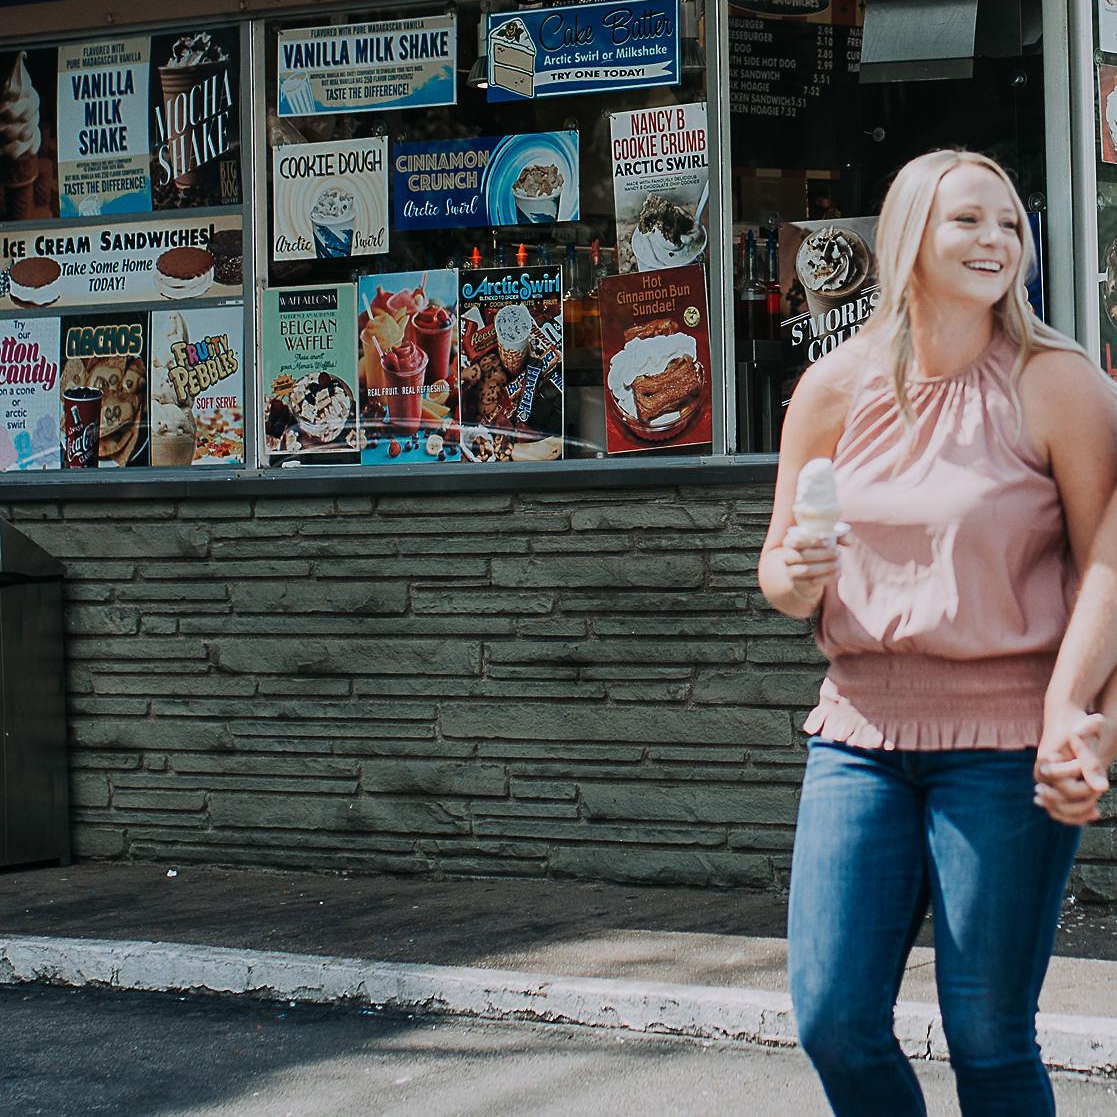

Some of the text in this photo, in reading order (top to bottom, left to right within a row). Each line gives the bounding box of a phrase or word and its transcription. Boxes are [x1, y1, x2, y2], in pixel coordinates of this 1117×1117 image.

[311, 21, 424, 38] FLAVORED WITH PURE MADAGASCAR VANILLA
[539, 8, 673, 52] Cake Batter
[83, 43, 125, 56] FLAVORED WITH
[283, 31, 449, 69] VANILLA MILK SHAKE
[734, 43, 833, 59] DOG 2.80
[816, 37, 833, 47] 3.10
[66, 52, 141, 69] PURE MADAGASCAR VANILLA
[544, 45, 668, 66] Arctic Swirl or Milkshake
[743, 57, 833, 70] SIDE HOT DOG 2.99
[551, 67, 645, 81] TRY ONE TODAY!
[740, 69, 780, 80] SANDWICH
[813, 74, 830, 84] 5.51
[72, 69, 134, 100] VANILLA
[326, 83, 409, 101] TASTE THE DIFFERENCE!
[740, 81, 770, 92] HOAGIE
[803, 86, 820, 96] 7.52
[155, 69, 232, 146] MOCHA
[751, 94, 807, 107] SANDWICH 5.51
[84, 99, 122, 127] MILK
[750, 104, 797, 117] HOAGIE 7.52
[631, 108, 685, 135] NANCY B
[79, 126, 128, 155] SHAKE
[158, 111, 230, 186] SHAKE
[613, 129, 706, 161] COOKIE CRUMB
[280, 149, 382, 179] COOKIE DOUGH
[396, 150, 490, 173] CINNAMON
[614, 154, 709, 177] ARCTIC SWIRL
[64, 176, 146, 195] TASTE THE DIFFERENCE!
[407, 171, 478, 192] CRUNCH
[403, 195, 479, 217] Arctic Swirl
[3, 224, 215, 258] ICE CREAM SANDWICHES!
[275, 228, 384, 252] Arctic Swirl
[61, 257, 153, 277] Take Some Home
[88, 277, 126, 292] TODAY!
[462, 273, 560, 300] Arctic Swirl
[642, 275, 662, 289] Hot
[616, 284, 690, 305] Cinnamon Bun
[632, 300, 676, 317] Sundae!
[13, 320, 26, 331] Try
[280, 319, 337, 335] BELGIAN
[791, 291, 881, 347] S'MORES
[18, 331, 31, 339] our
[66, 324, 143, 359] NACHOS
[284, 335, 334, 351] WAFFLE
[0, 336, 39, 364] tton
[168, 349, 239, 408] PEBBLES
[16, 386, 36, 395] cone
[367, 388, 381, 397] REAL
[382, 387, 399, 396] FRUIT.
[402, 386, 415, 394] REAL
[196, 396, 237, 410] SOFT SERVE
[5, 408, 27, 418] arctic
[7, 419, 26, 429] swirl
